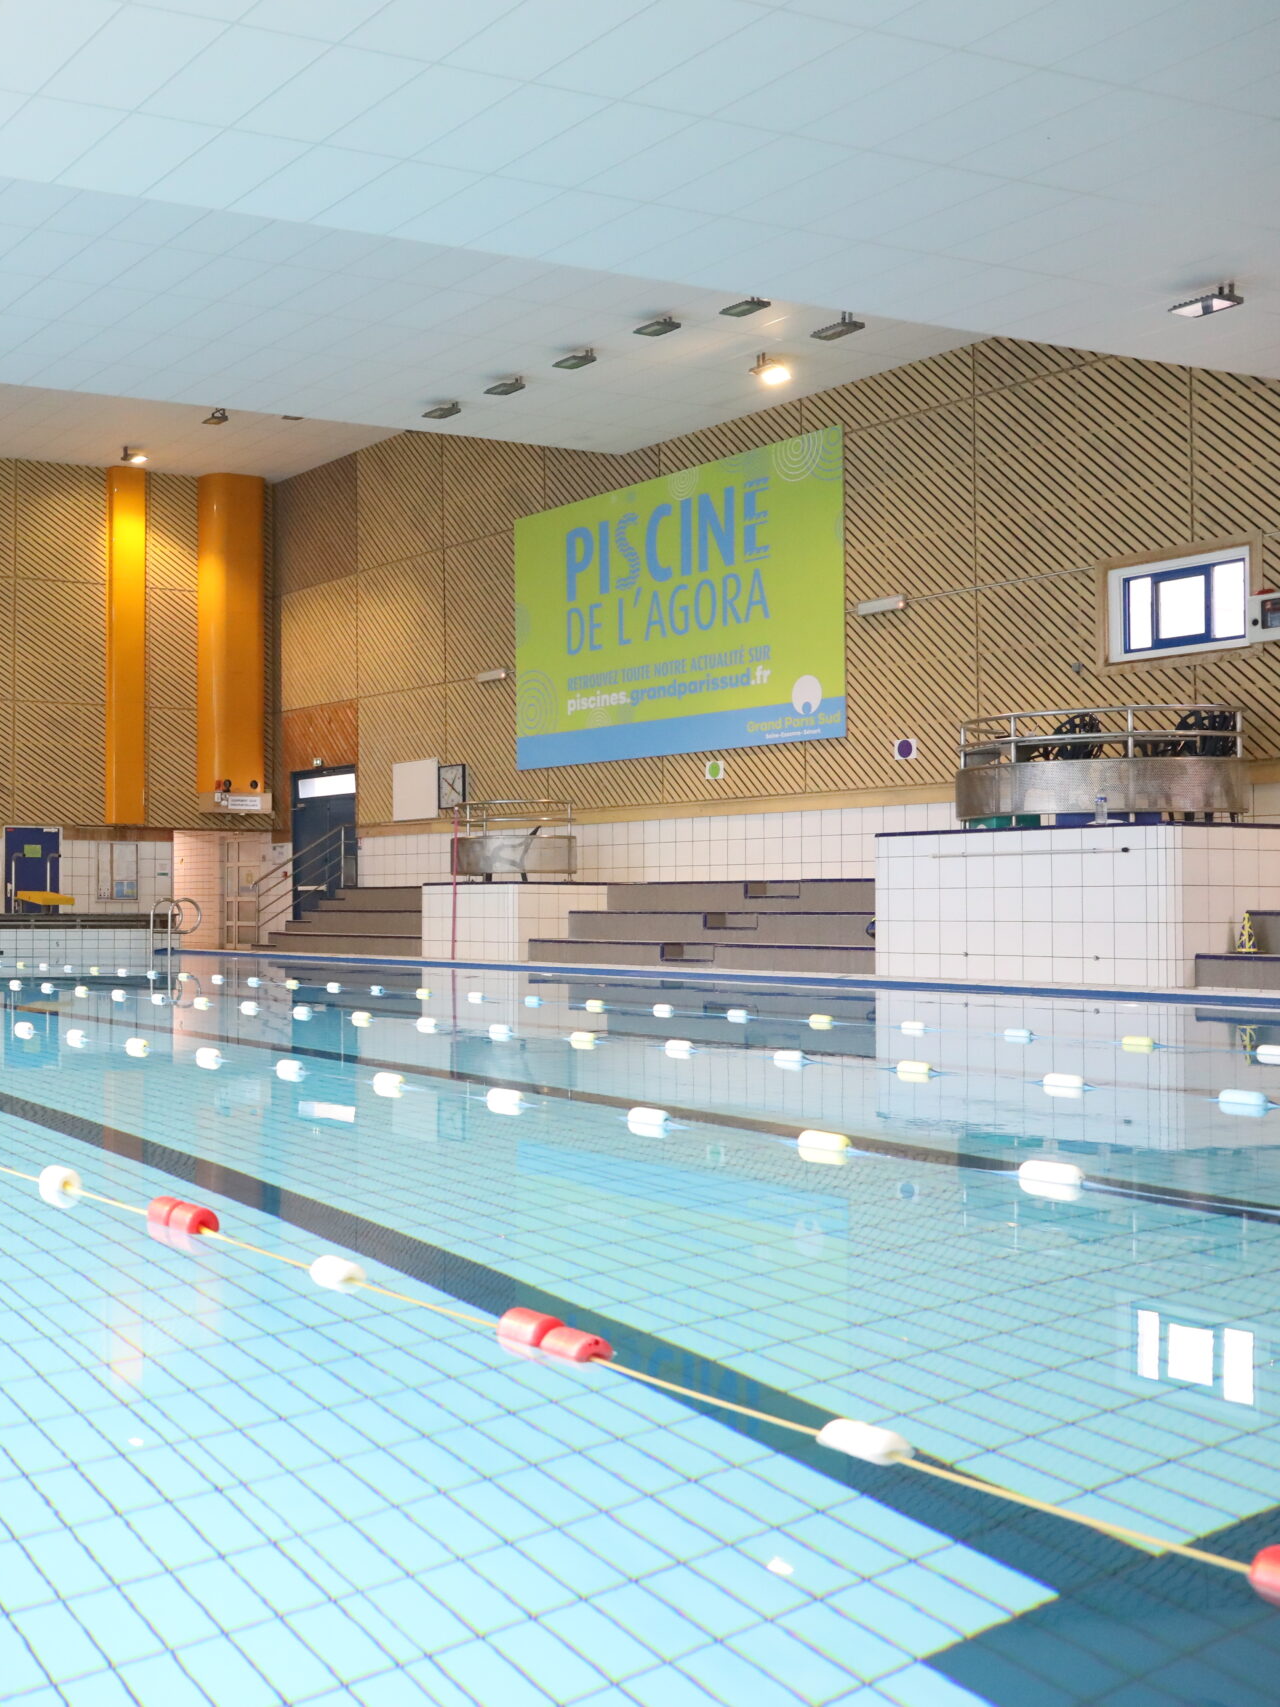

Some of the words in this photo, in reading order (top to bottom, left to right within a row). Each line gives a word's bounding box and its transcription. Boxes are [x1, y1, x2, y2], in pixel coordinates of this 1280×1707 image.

[566, 477, 771, 602] PISCINE
[567, 602, 603, 655] DE
[618, 568, 771, 646] L'AGORA
[567, 665, 772, 716] piscines.grandparissud.fr
[568, 670, 618, 692] RETROUVEZ
[622, 663, 651, 683] TOUTE
[654, 658, 688, 678] NOTRE
[690, 645, 745, 673] ACTUALITÉ
[748, 644, 772, 664] SUR
[747, 718, 783, 733] Grand
[784, 715, 815, 729] Paris
[818, 709, 842, 725] Sud
